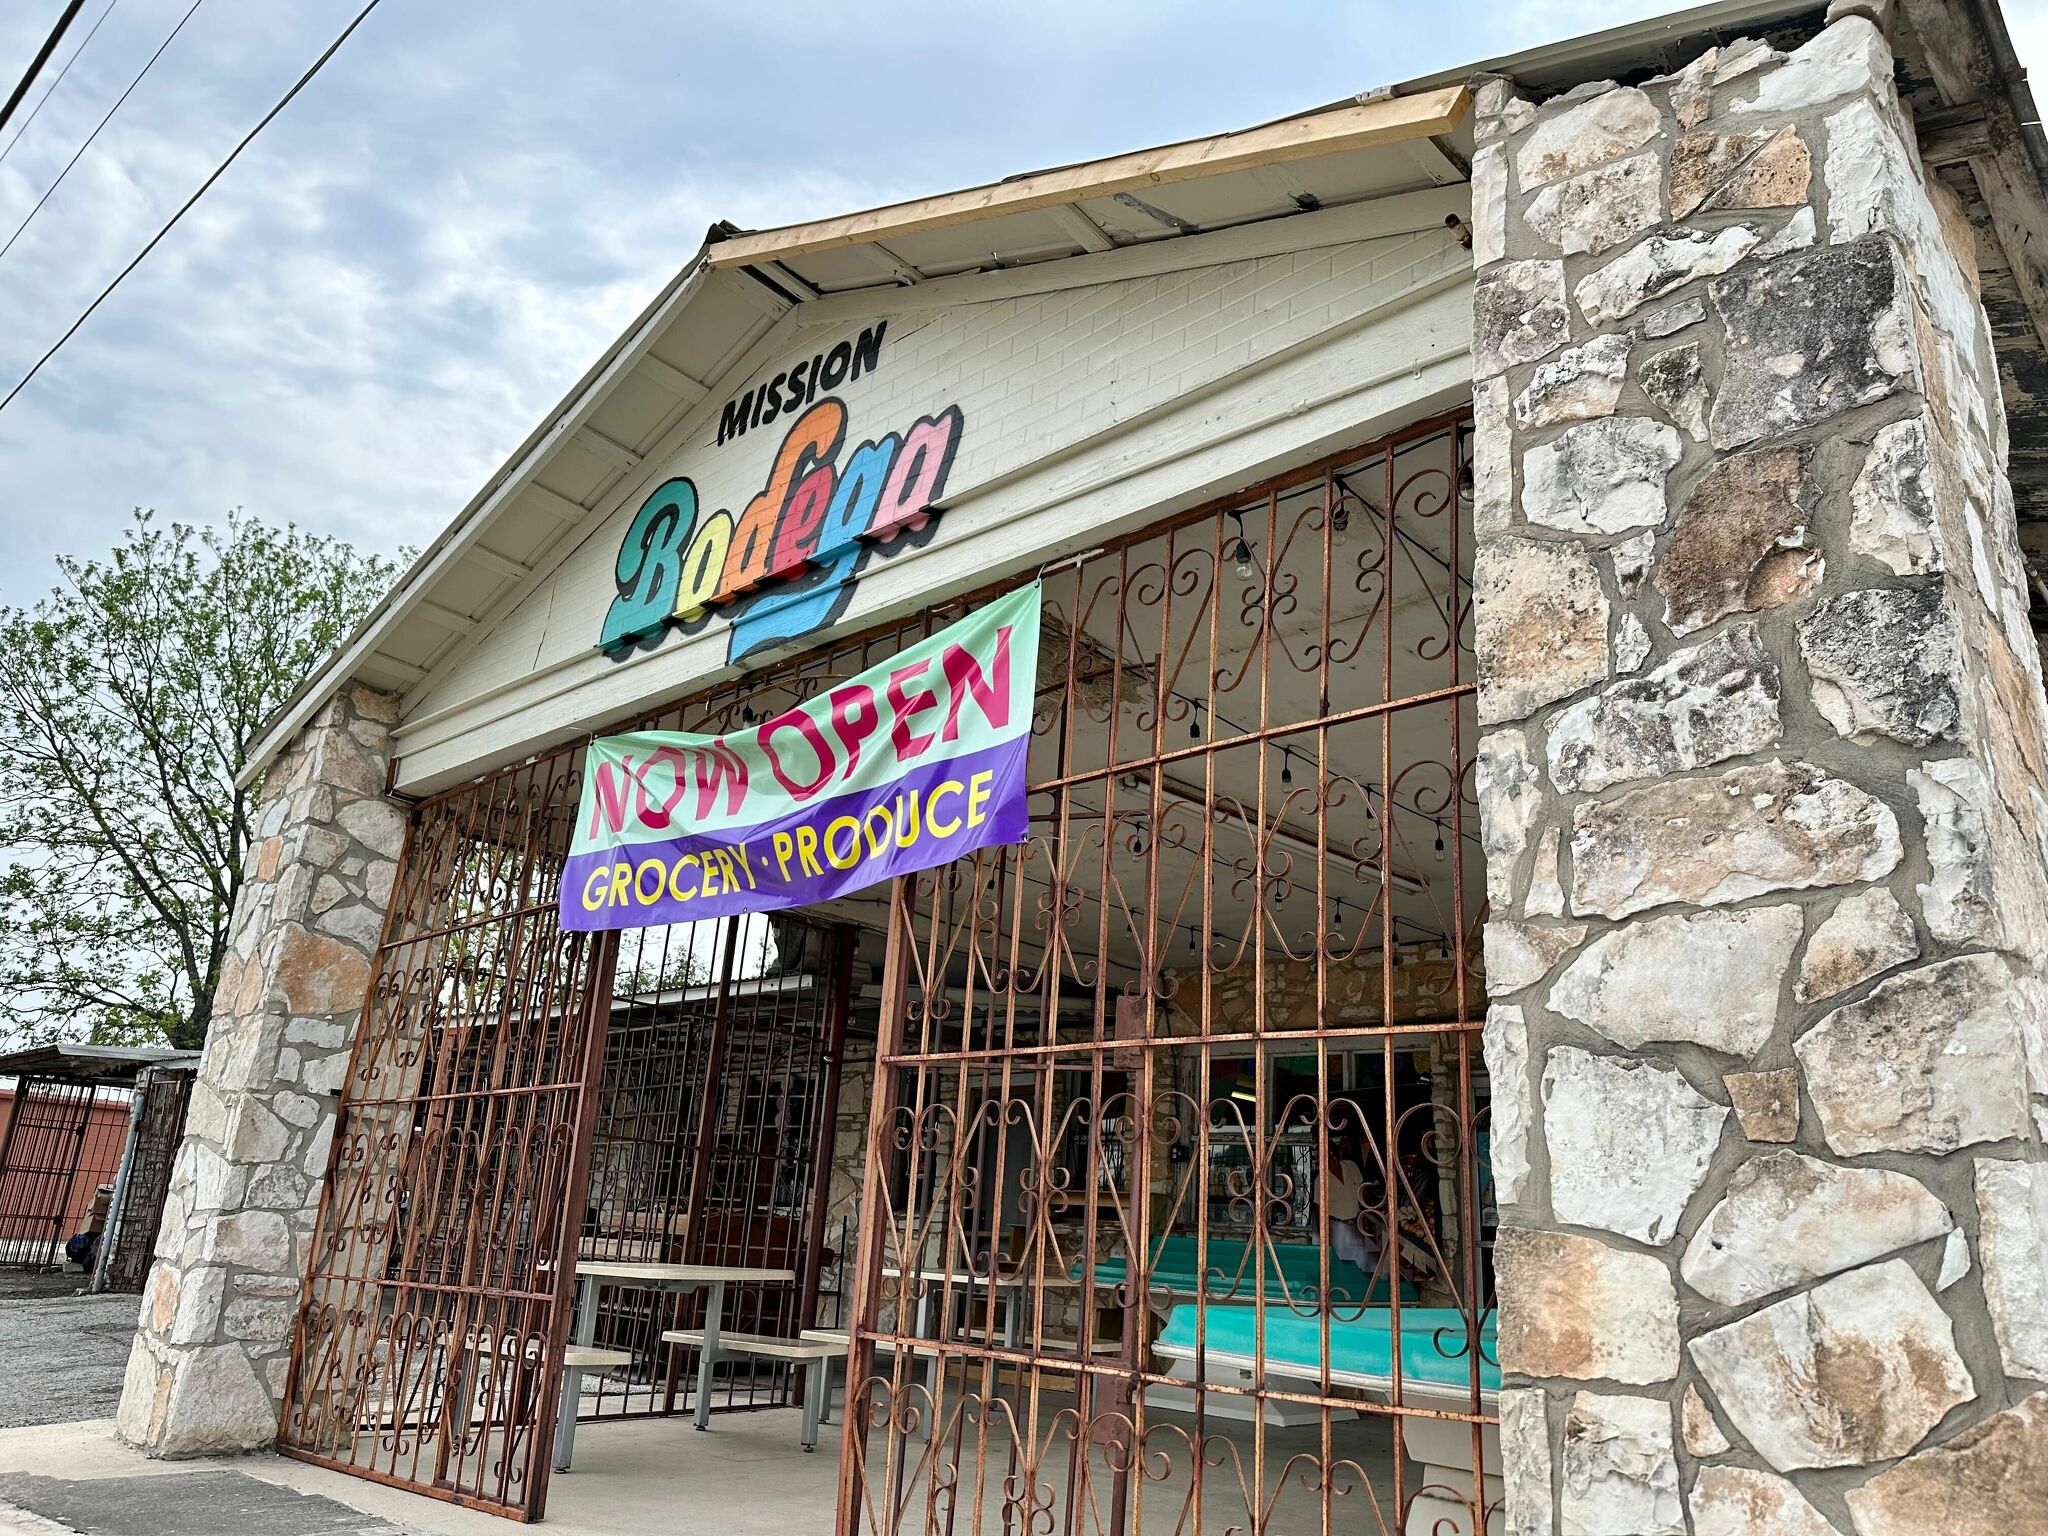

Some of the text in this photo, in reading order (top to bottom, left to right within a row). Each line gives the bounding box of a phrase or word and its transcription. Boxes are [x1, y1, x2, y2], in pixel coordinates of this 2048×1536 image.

[717, 320, 888, 447] MISSION
[599, 397, 963, 666] Bodega
[589, 625, 1014, 841] NOW OPEN
[582, 842, 756, 912] GROCERY
[772, 769, 994, 883] PRODUCE
